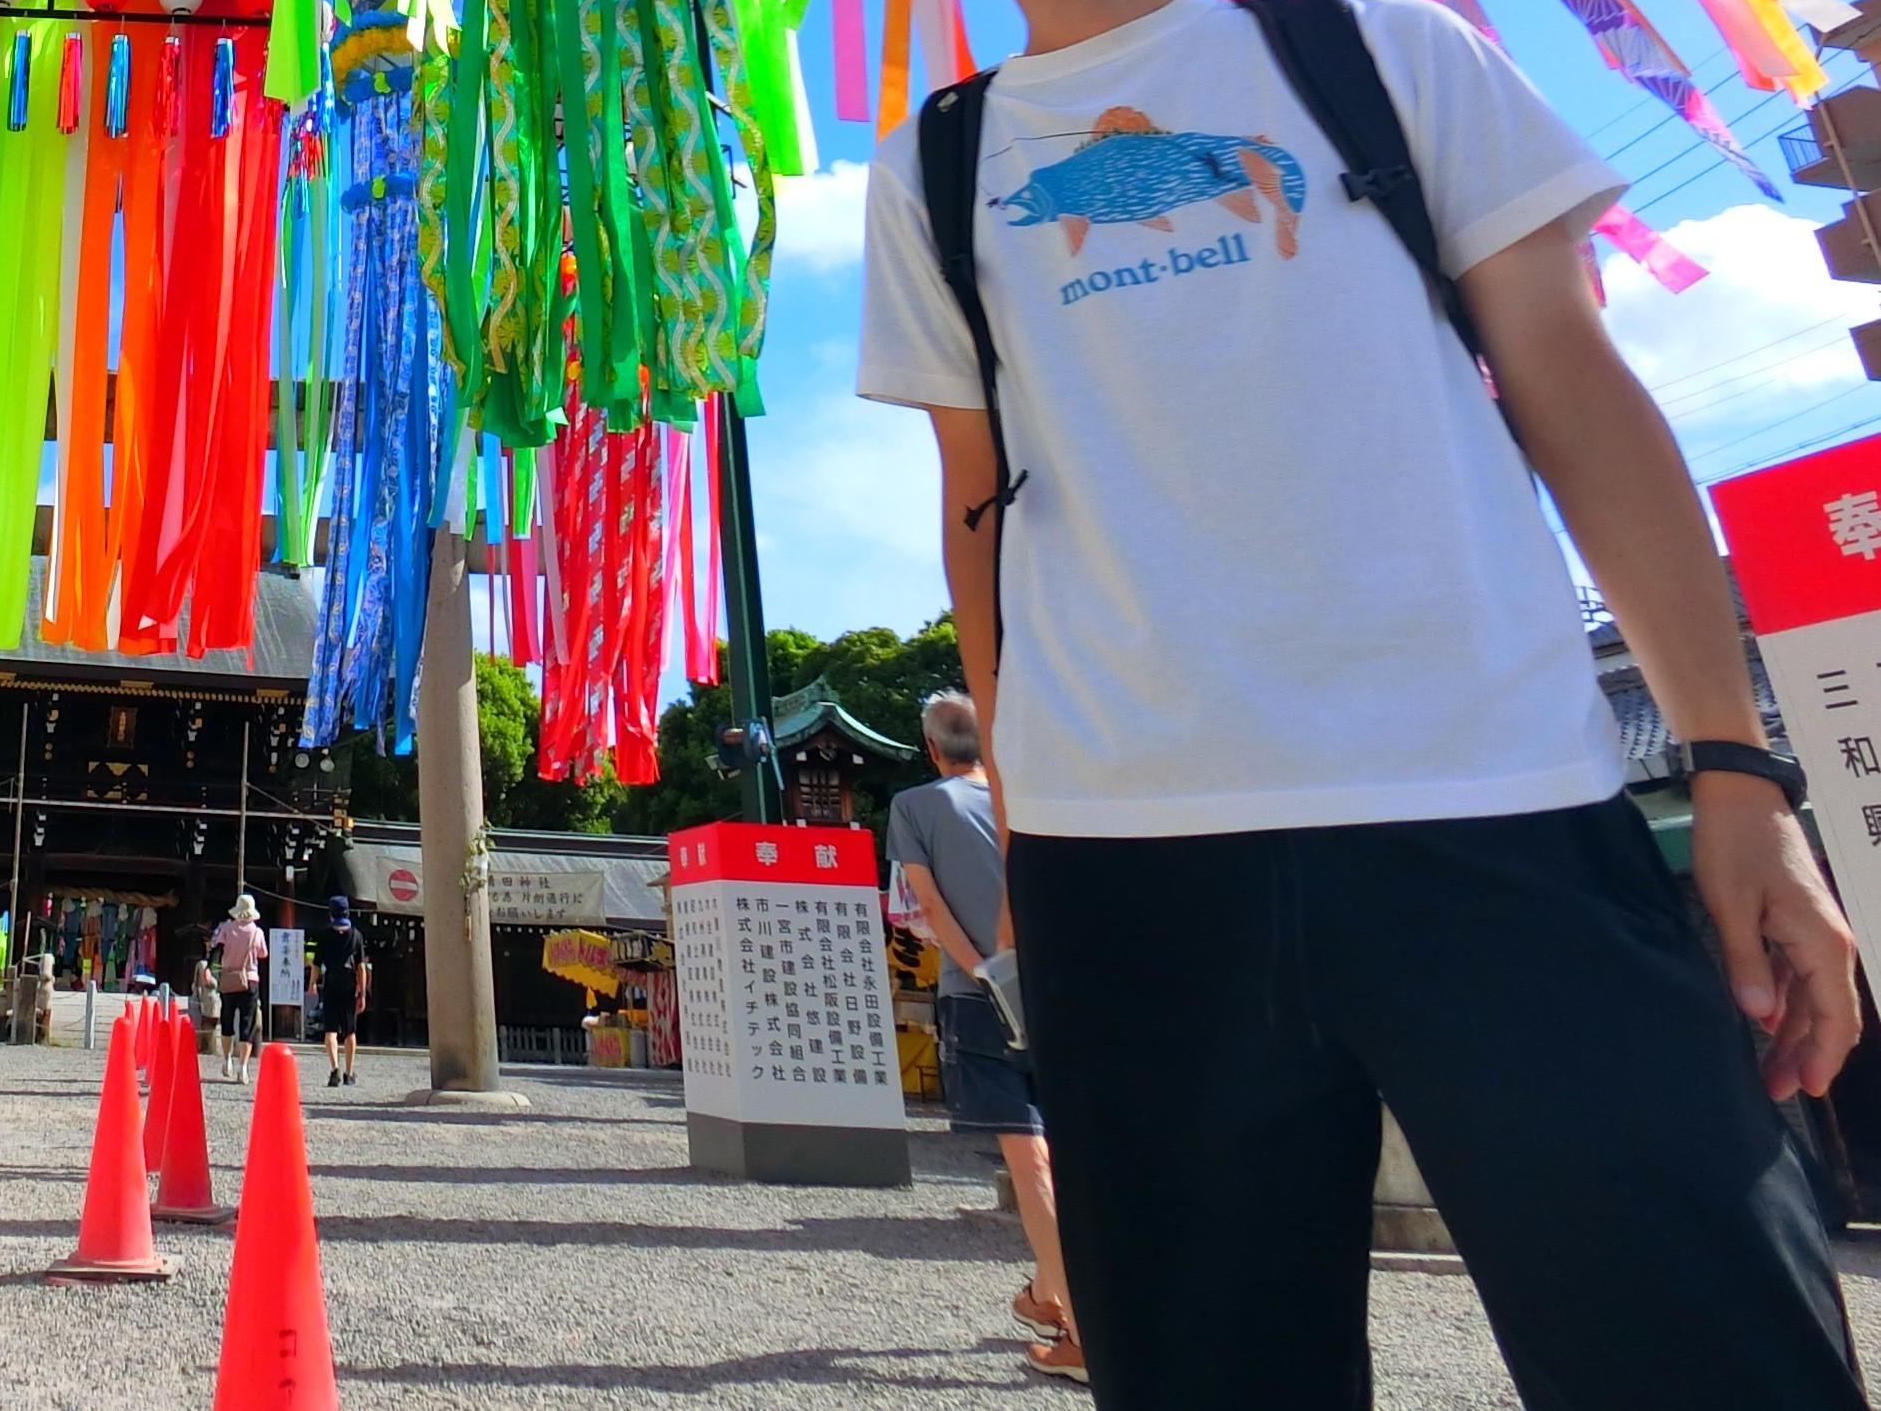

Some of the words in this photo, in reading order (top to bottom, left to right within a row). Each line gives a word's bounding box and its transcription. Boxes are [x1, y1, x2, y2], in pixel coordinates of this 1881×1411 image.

[755, 841, 839, 870] 奉献
[736, 897, 764, 1080] 株式会社イチテック
[755, 898, 787, 1082] 市川建設株式会社
[775, 902, 807, 1083] 一宮市建設協同組合
[834, 901, 868, 1085] 有限会社日野設備
